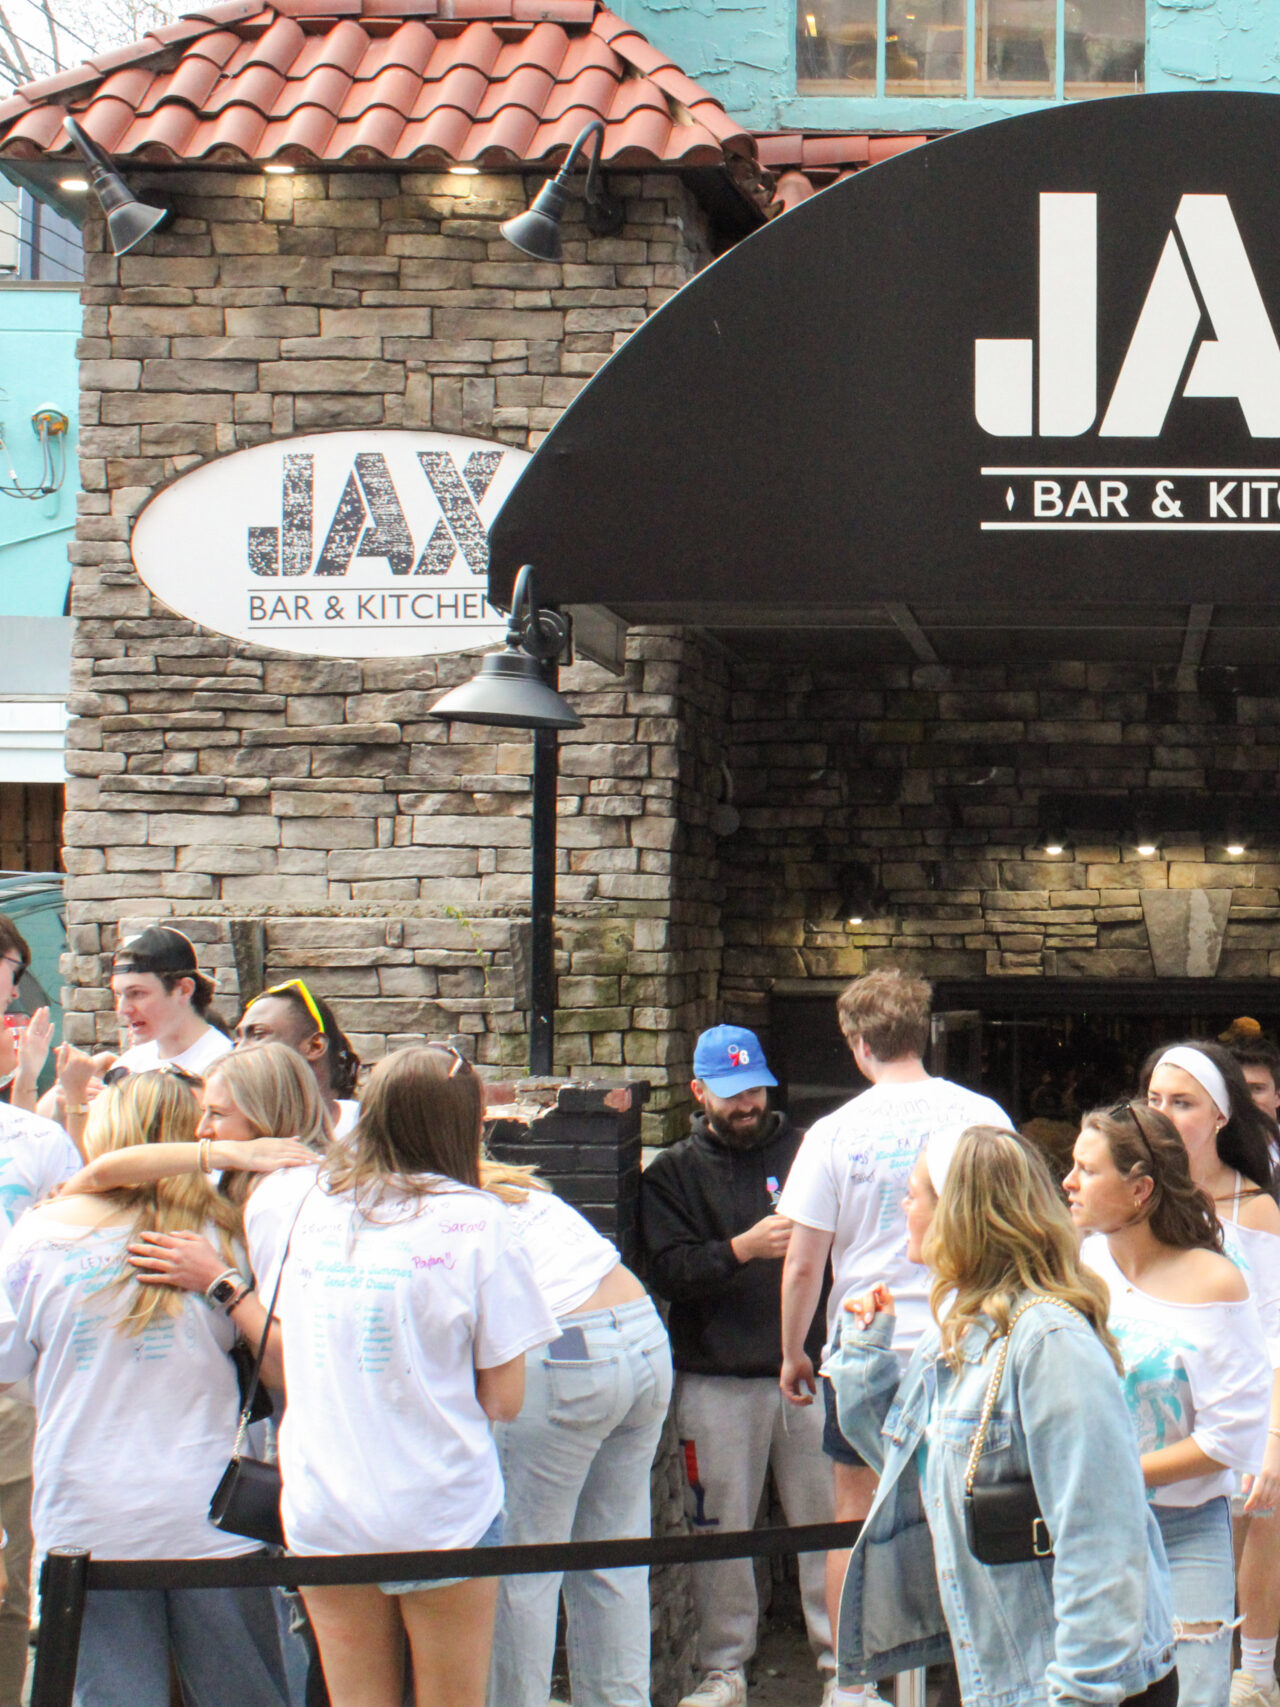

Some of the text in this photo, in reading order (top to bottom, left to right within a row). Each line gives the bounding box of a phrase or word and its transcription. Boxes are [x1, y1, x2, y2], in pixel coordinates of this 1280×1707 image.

[248, 451, 504, 576] JAX
[1033, 481, 1128, 518] BAR
[1151, 480, 1184, 518] &
[250, 595, 313, 620] BAR
[324, 595, 345, 619] &
